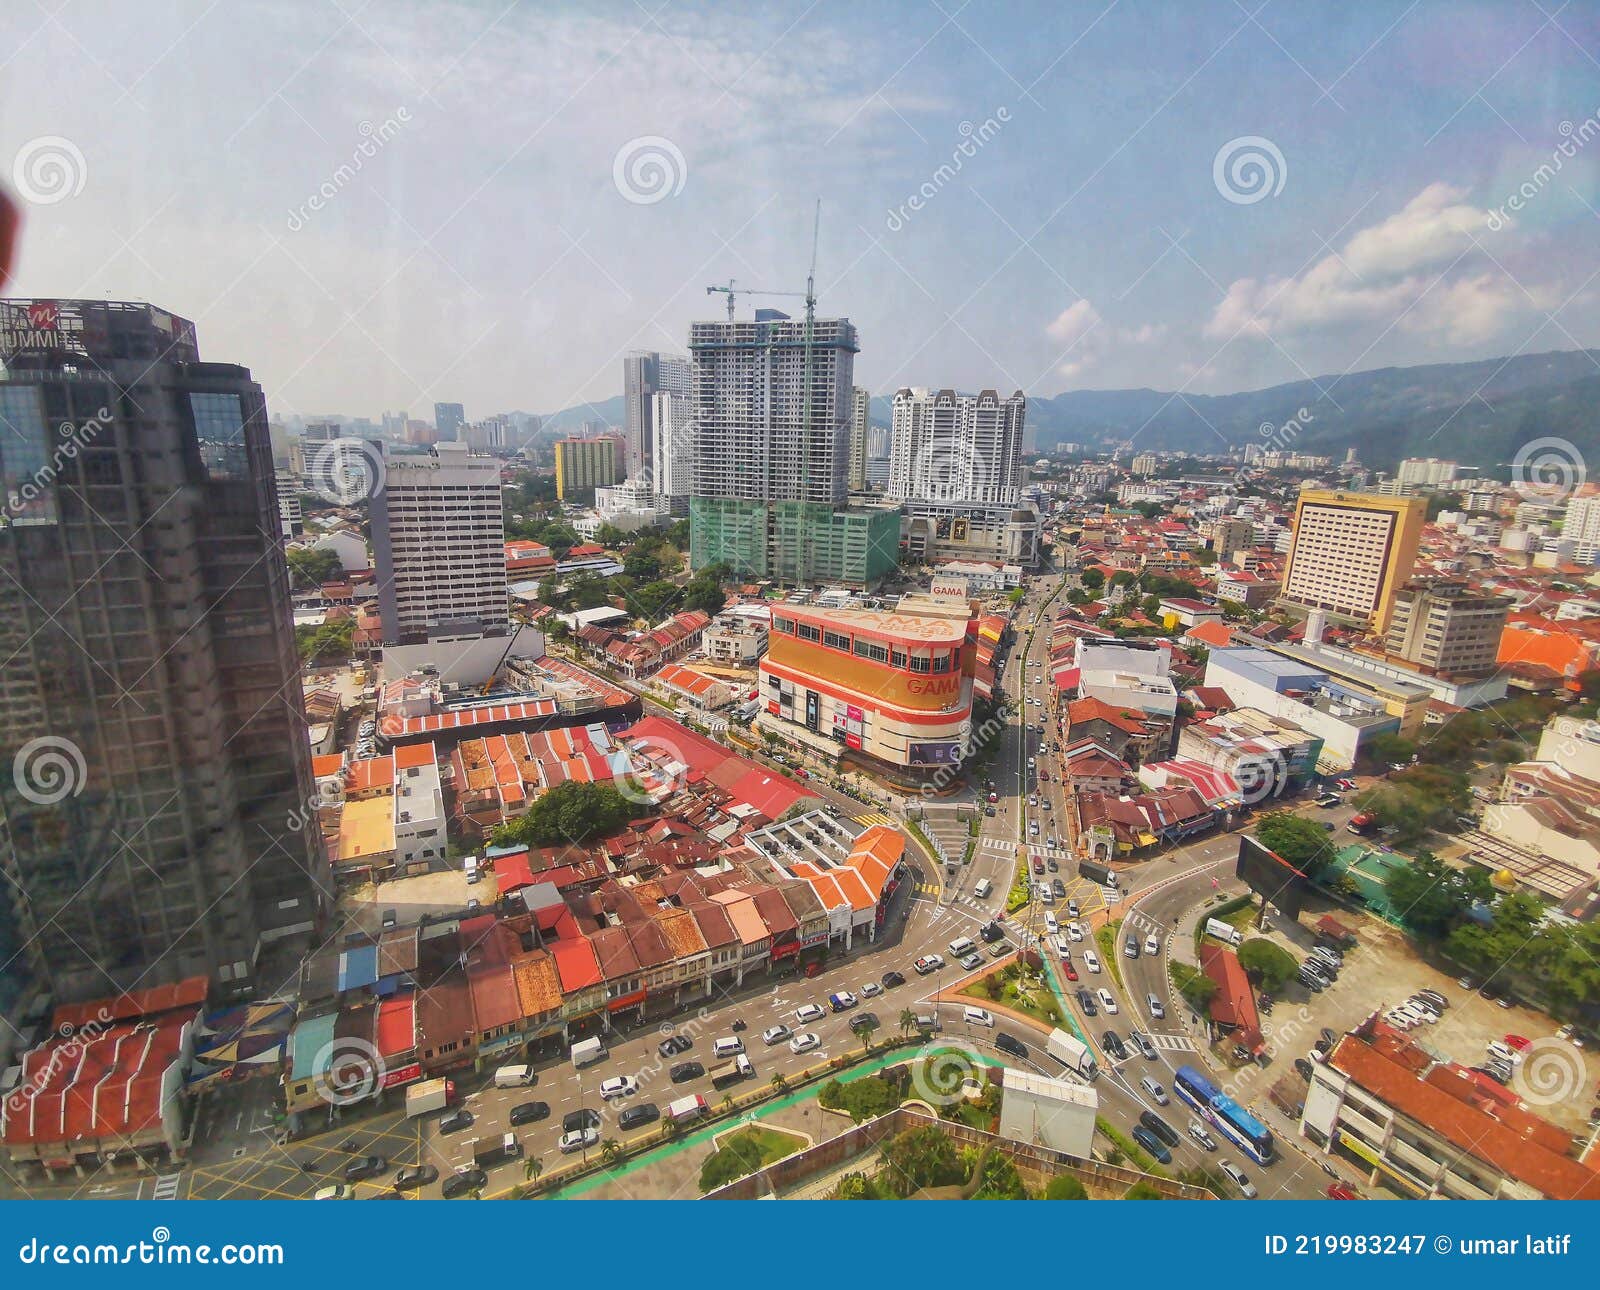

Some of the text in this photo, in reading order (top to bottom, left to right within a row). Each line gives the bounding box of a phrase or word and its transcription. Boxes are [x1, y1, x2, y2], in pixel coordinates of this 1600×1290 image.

[0, 331, 71, 348] UMMIT
[933, 586, 963, 597] GAMA
[907, 678, 960, 695] GAMA
